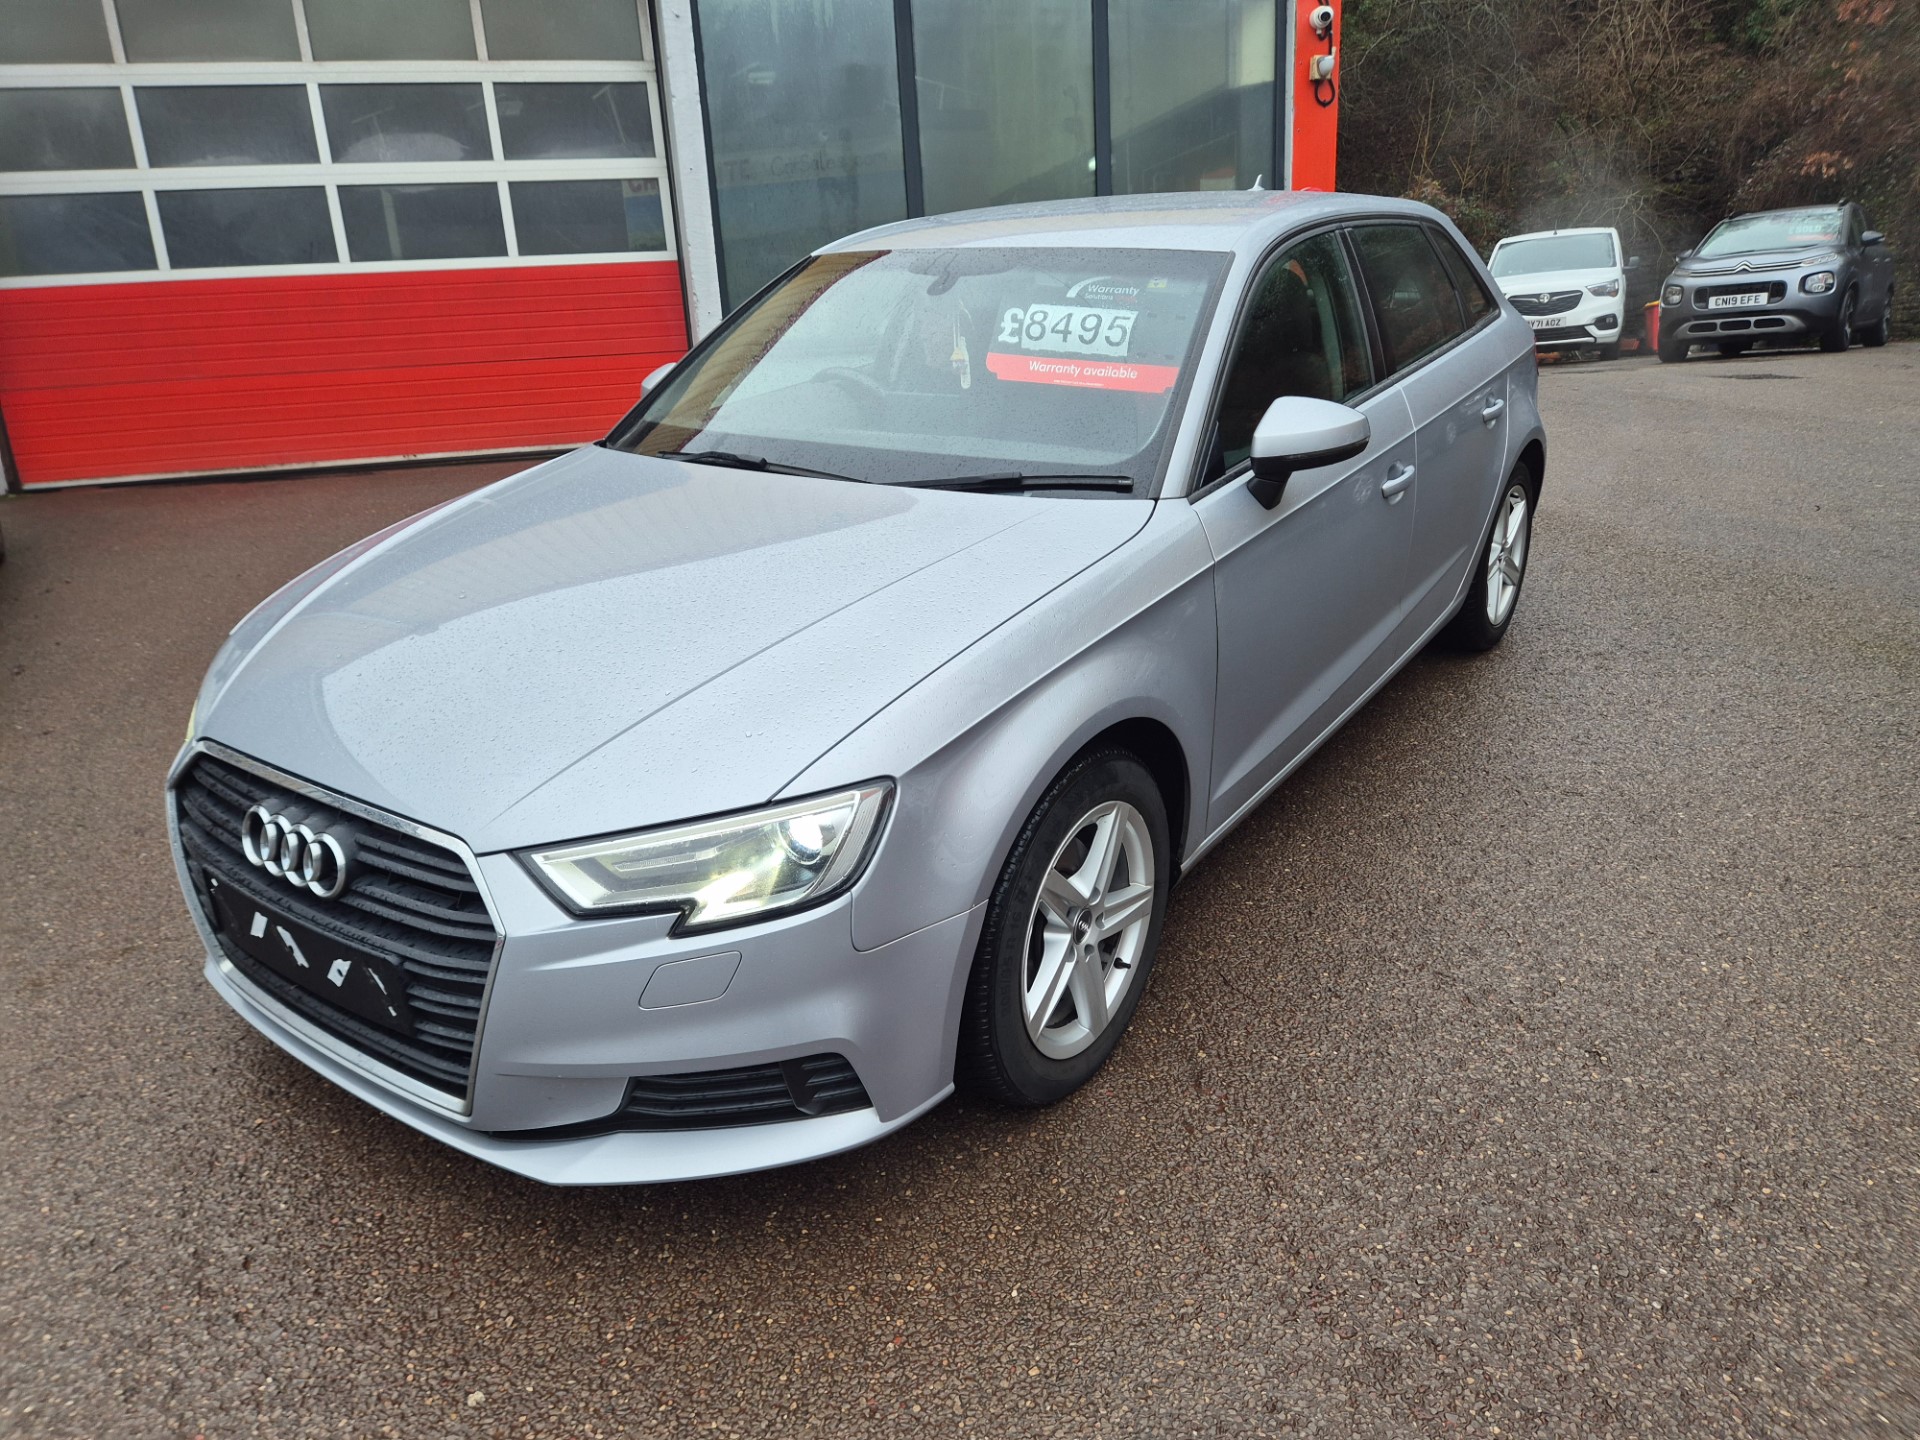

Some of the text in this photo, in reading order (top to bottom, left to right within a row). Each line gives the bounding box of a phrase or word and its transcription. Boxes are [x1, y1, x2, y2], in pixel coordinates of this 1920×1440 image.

[1088, 283, 1140, 296] Warranty
[1714, 294, 1761, 307] CN19 EFE
[998, 307, 1131, 347] £8495
[1029, 360, 1138, 379] Warranty available
